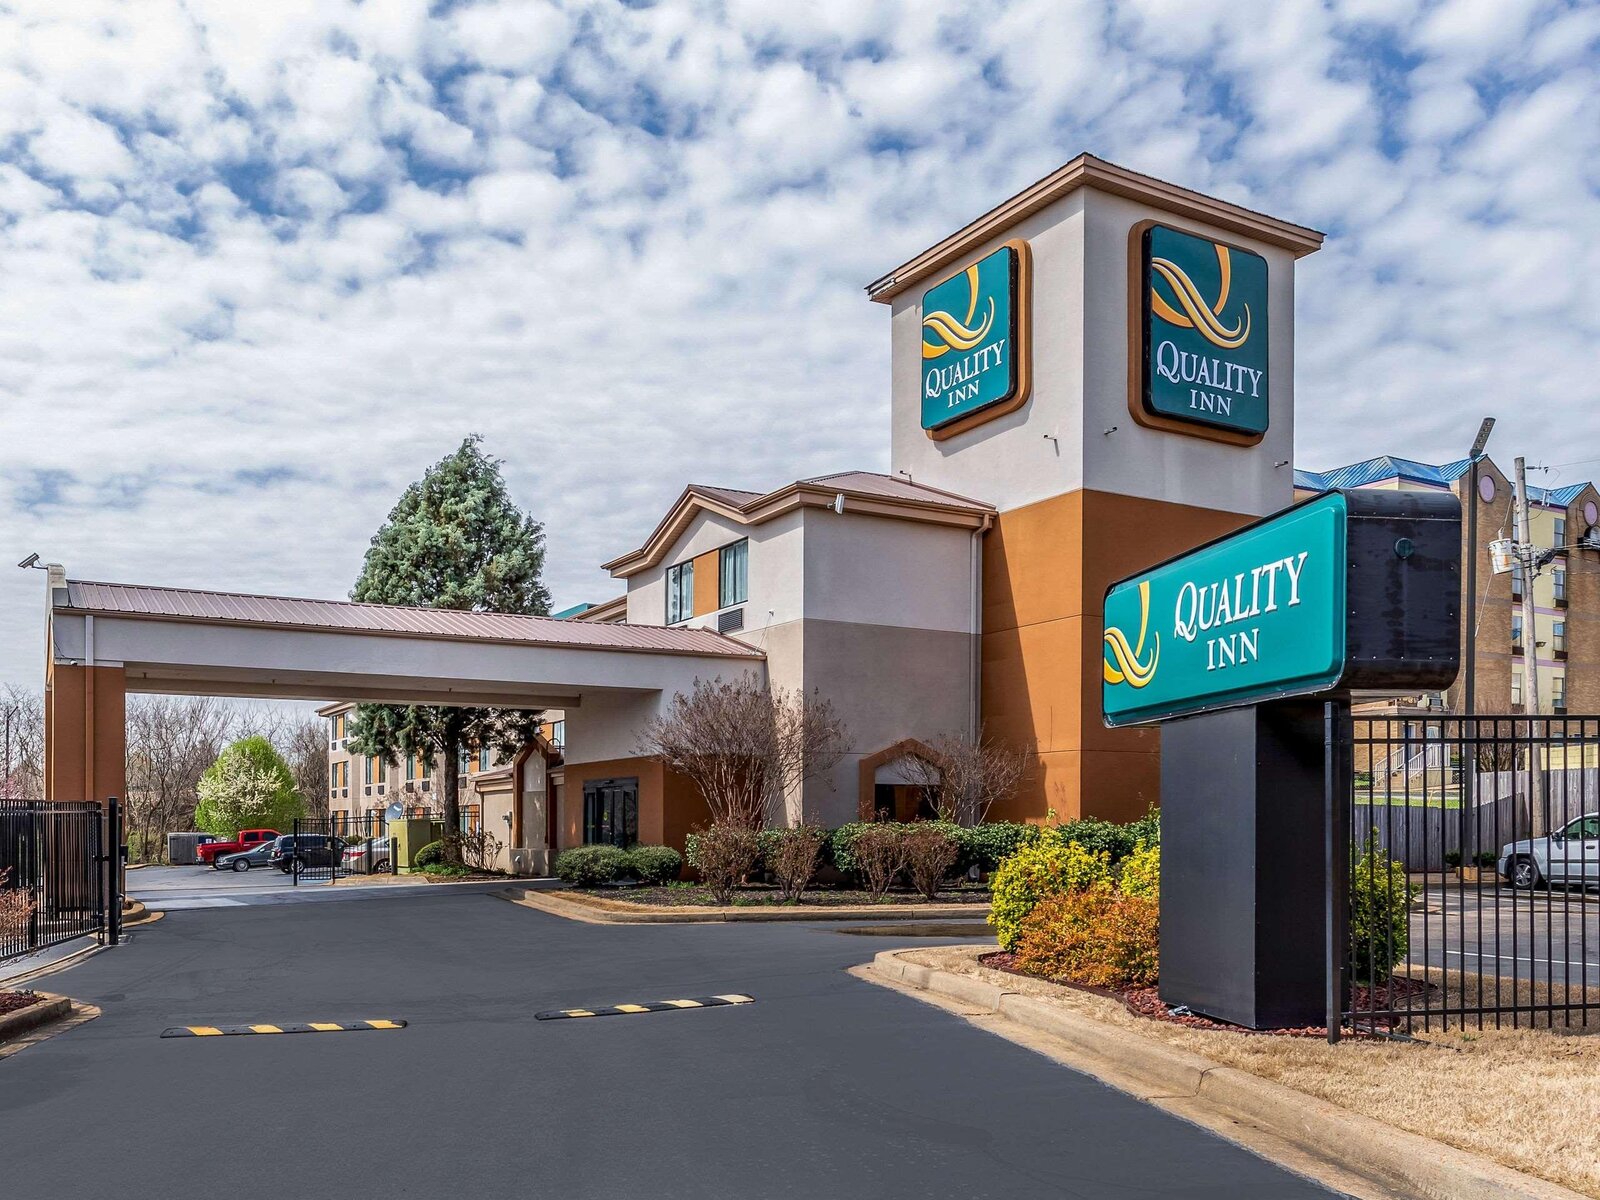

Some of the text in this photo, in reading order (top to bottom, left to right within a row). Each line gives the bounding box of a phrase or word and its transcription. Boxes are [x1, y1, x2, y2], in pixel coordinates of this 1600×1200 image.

[925, 339, 1005, 399] QUALITY
[1157, 340, 1263, 397] QUALITY
[947, 380, 979, 408] INN
[1190, 389, 1231, 416] INN
[1174, 552, 1308, 642] QUALITY
[1207, 628, 1259, 671] INN
